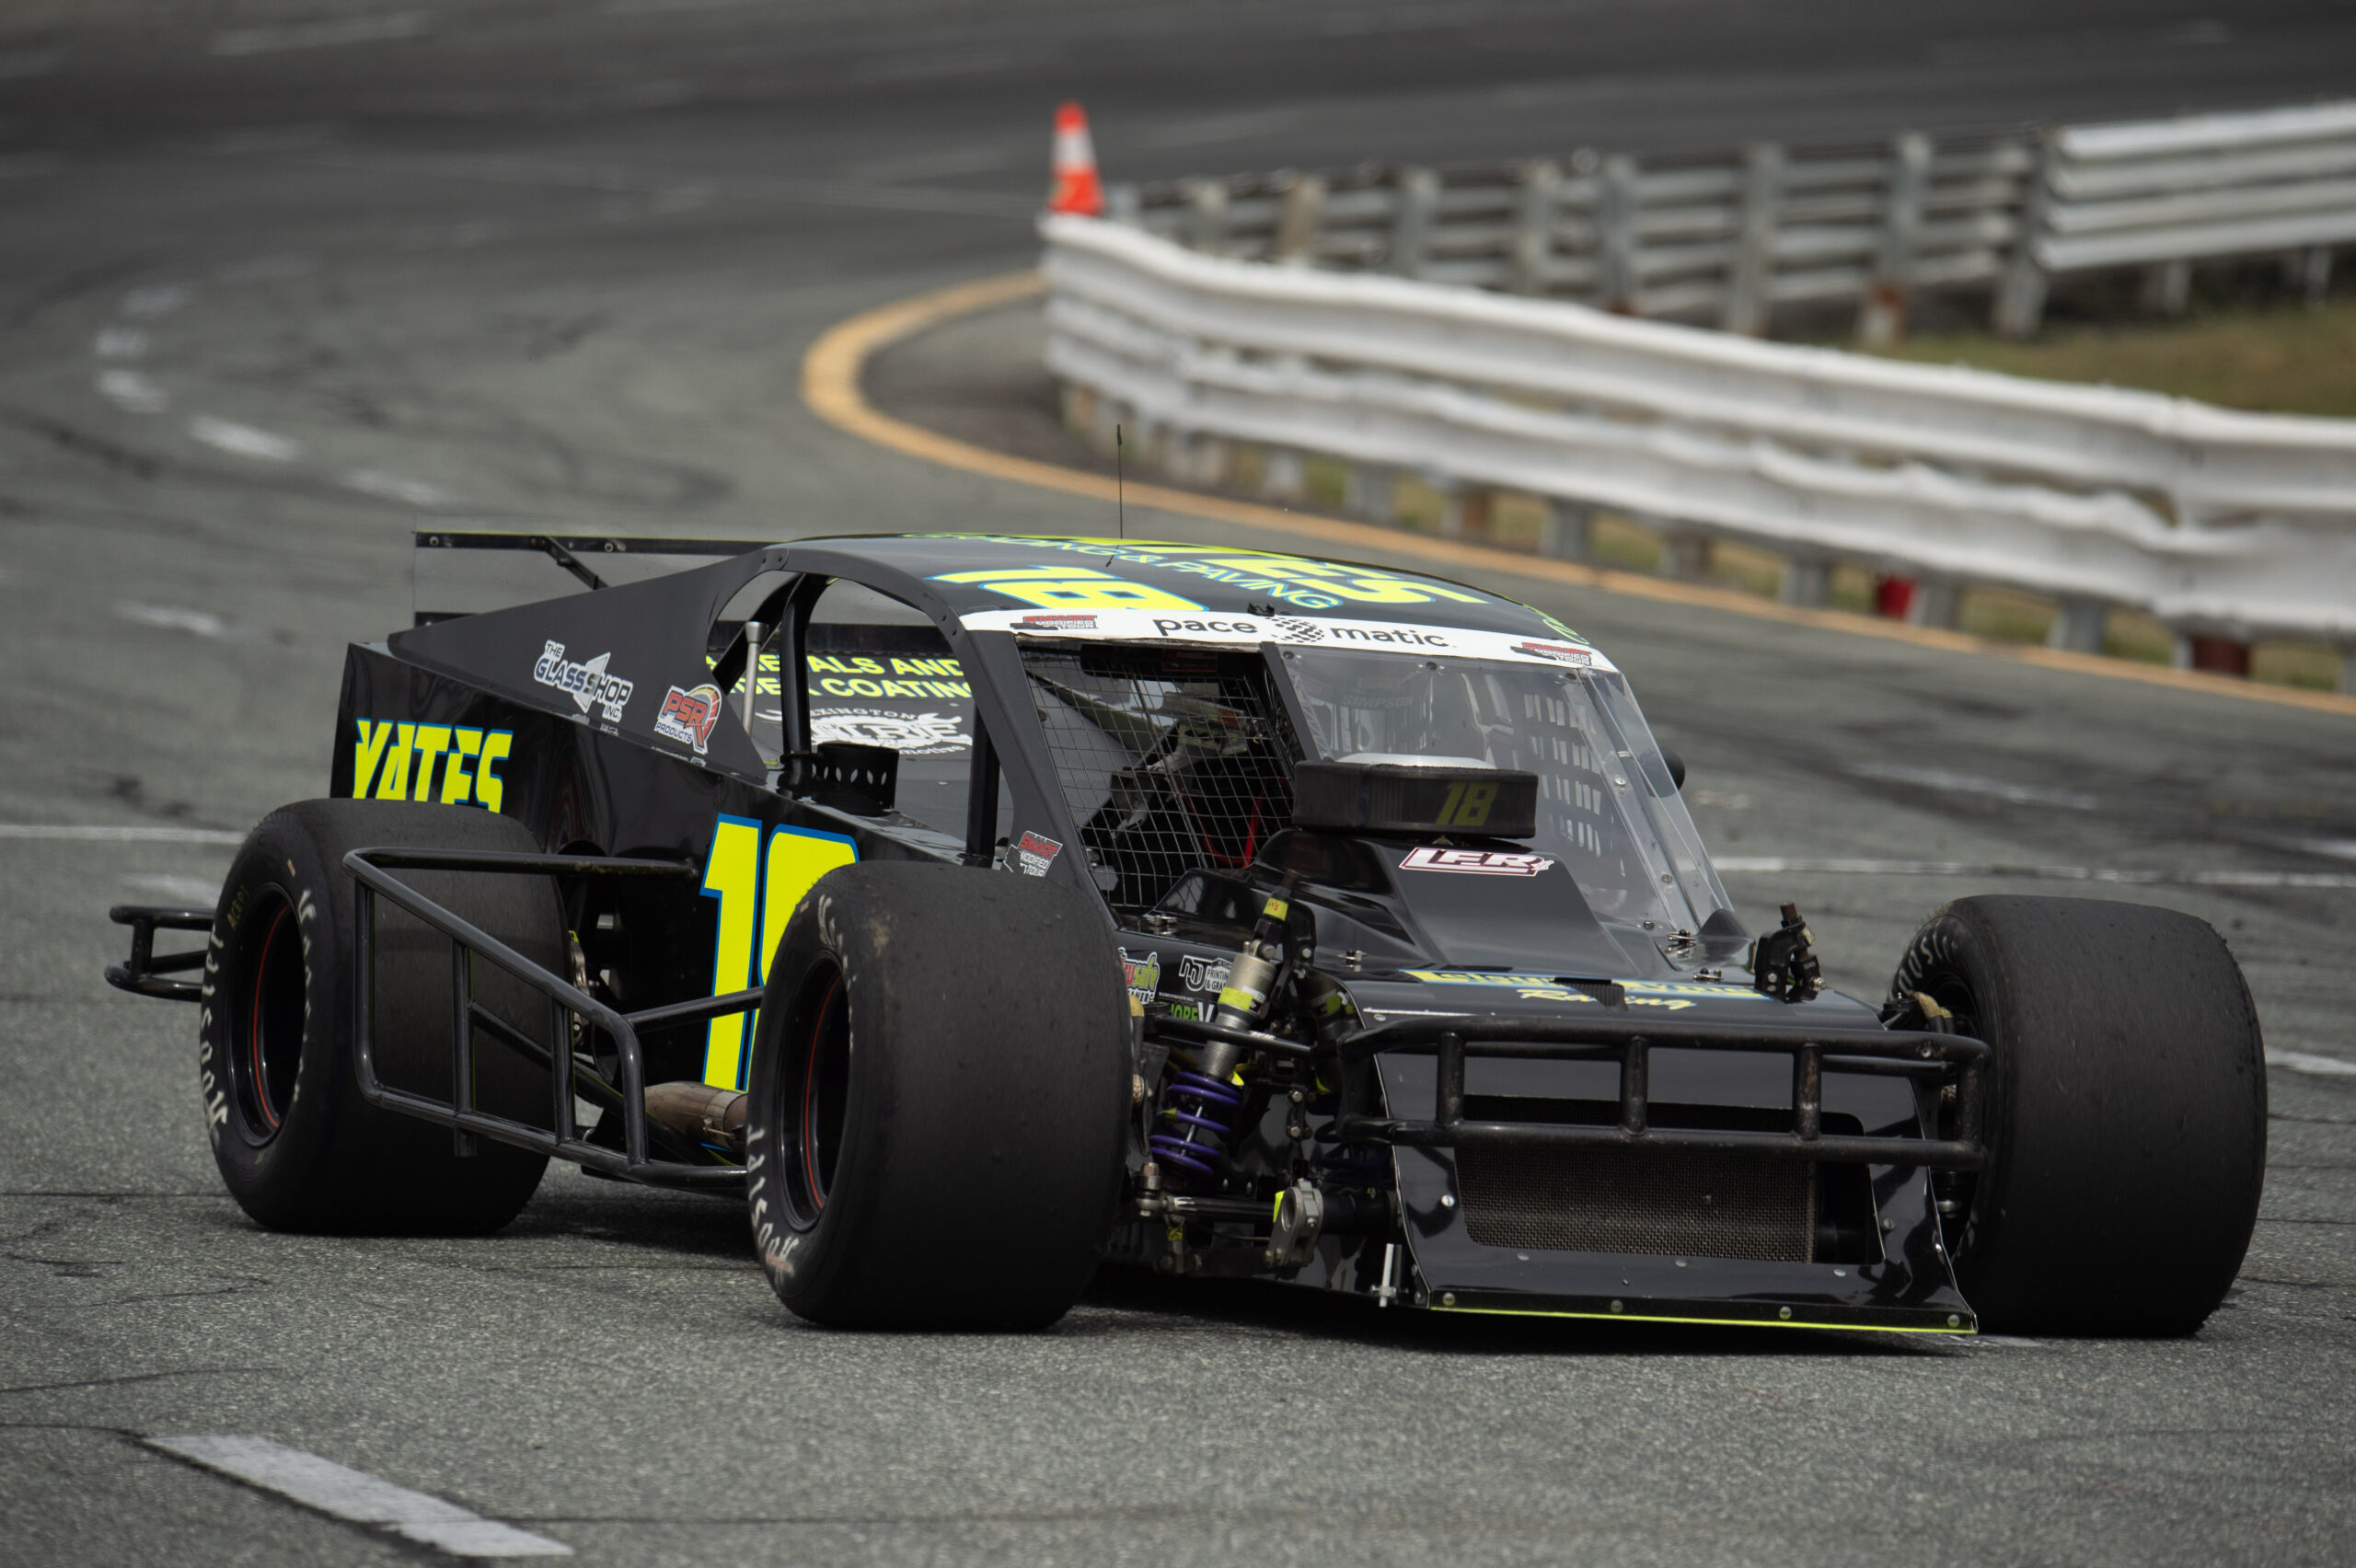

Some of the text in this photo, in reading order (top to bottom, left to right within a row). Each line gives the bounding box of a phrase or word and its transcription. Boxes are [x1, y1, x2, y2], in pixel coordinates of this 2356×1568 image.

[1154, 560, 1343, 609] PAVING
[1153, 617, 1447, 648] pace matic
[546, 642, 562, 658] THE
[1341, 694, 1415, 709] SIMPSON
[655, 721, 693, 744] PRODUCTS
[662, 690, 709, 749] PSR
[352, 717, 514, 813] YATES
[1436, 781, 1499, 826] 18
[1019, 834, 1058, 860] SMART
[1403, 847, 1544, 874] LFR
[1516, 988, 1697, 1009] Raing
